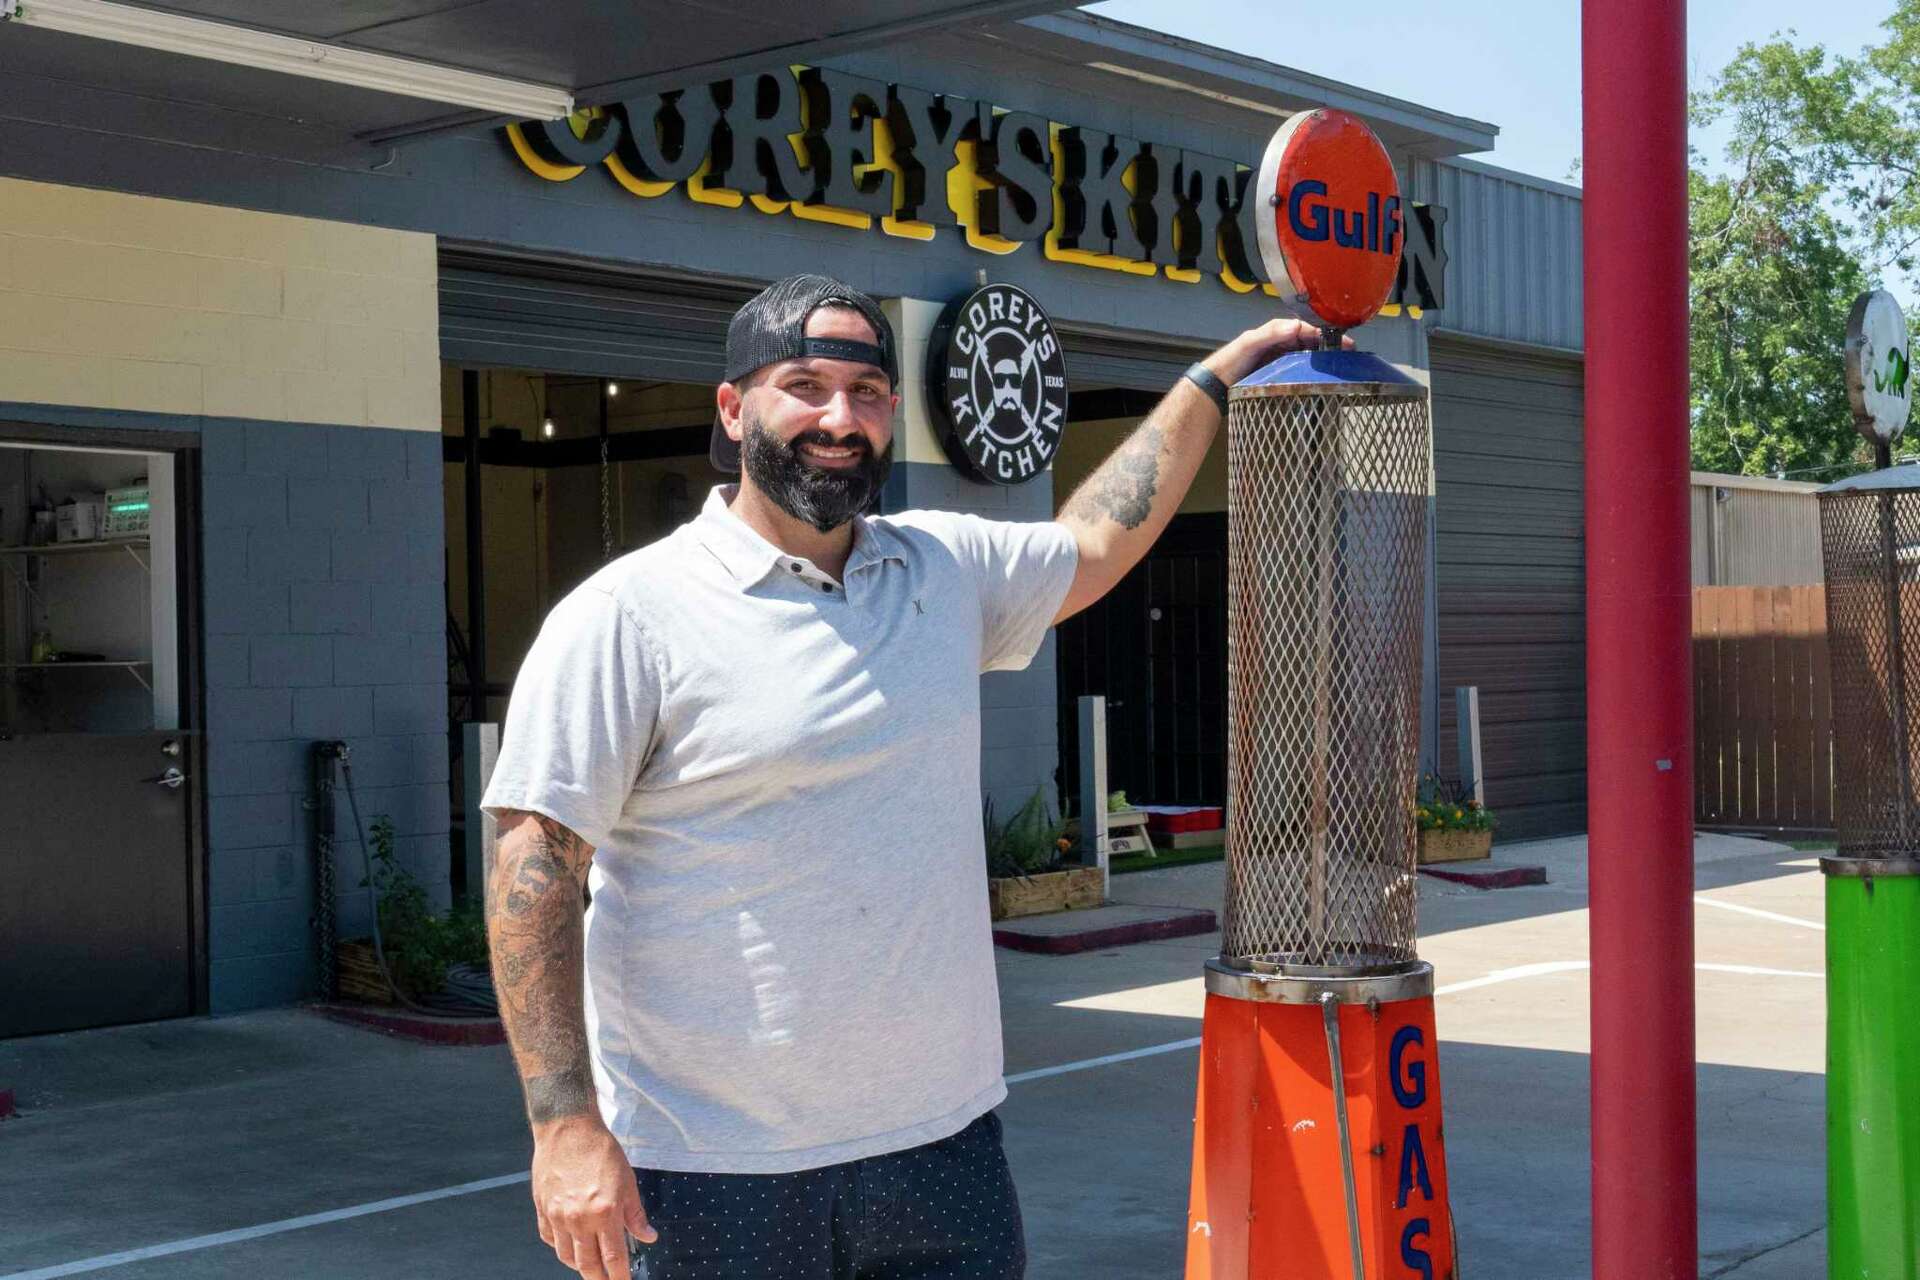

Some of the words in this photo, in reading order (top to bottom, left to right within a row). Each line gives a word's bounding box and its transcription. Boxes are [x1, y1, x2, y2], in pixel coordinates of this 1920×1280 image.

[1050, 122, 1448, 317] KITN
[1289, 179, 1400, 256] Gulf
[955, 292, 1056, 362] COREY'S
[949, 366, 968, 380] ALVIN
[1044, 375, 1064, 389] TEXAS
[952, 392, 1063, 478] KITCHEN
[1389, 1025, 1433, 1280] GAS
